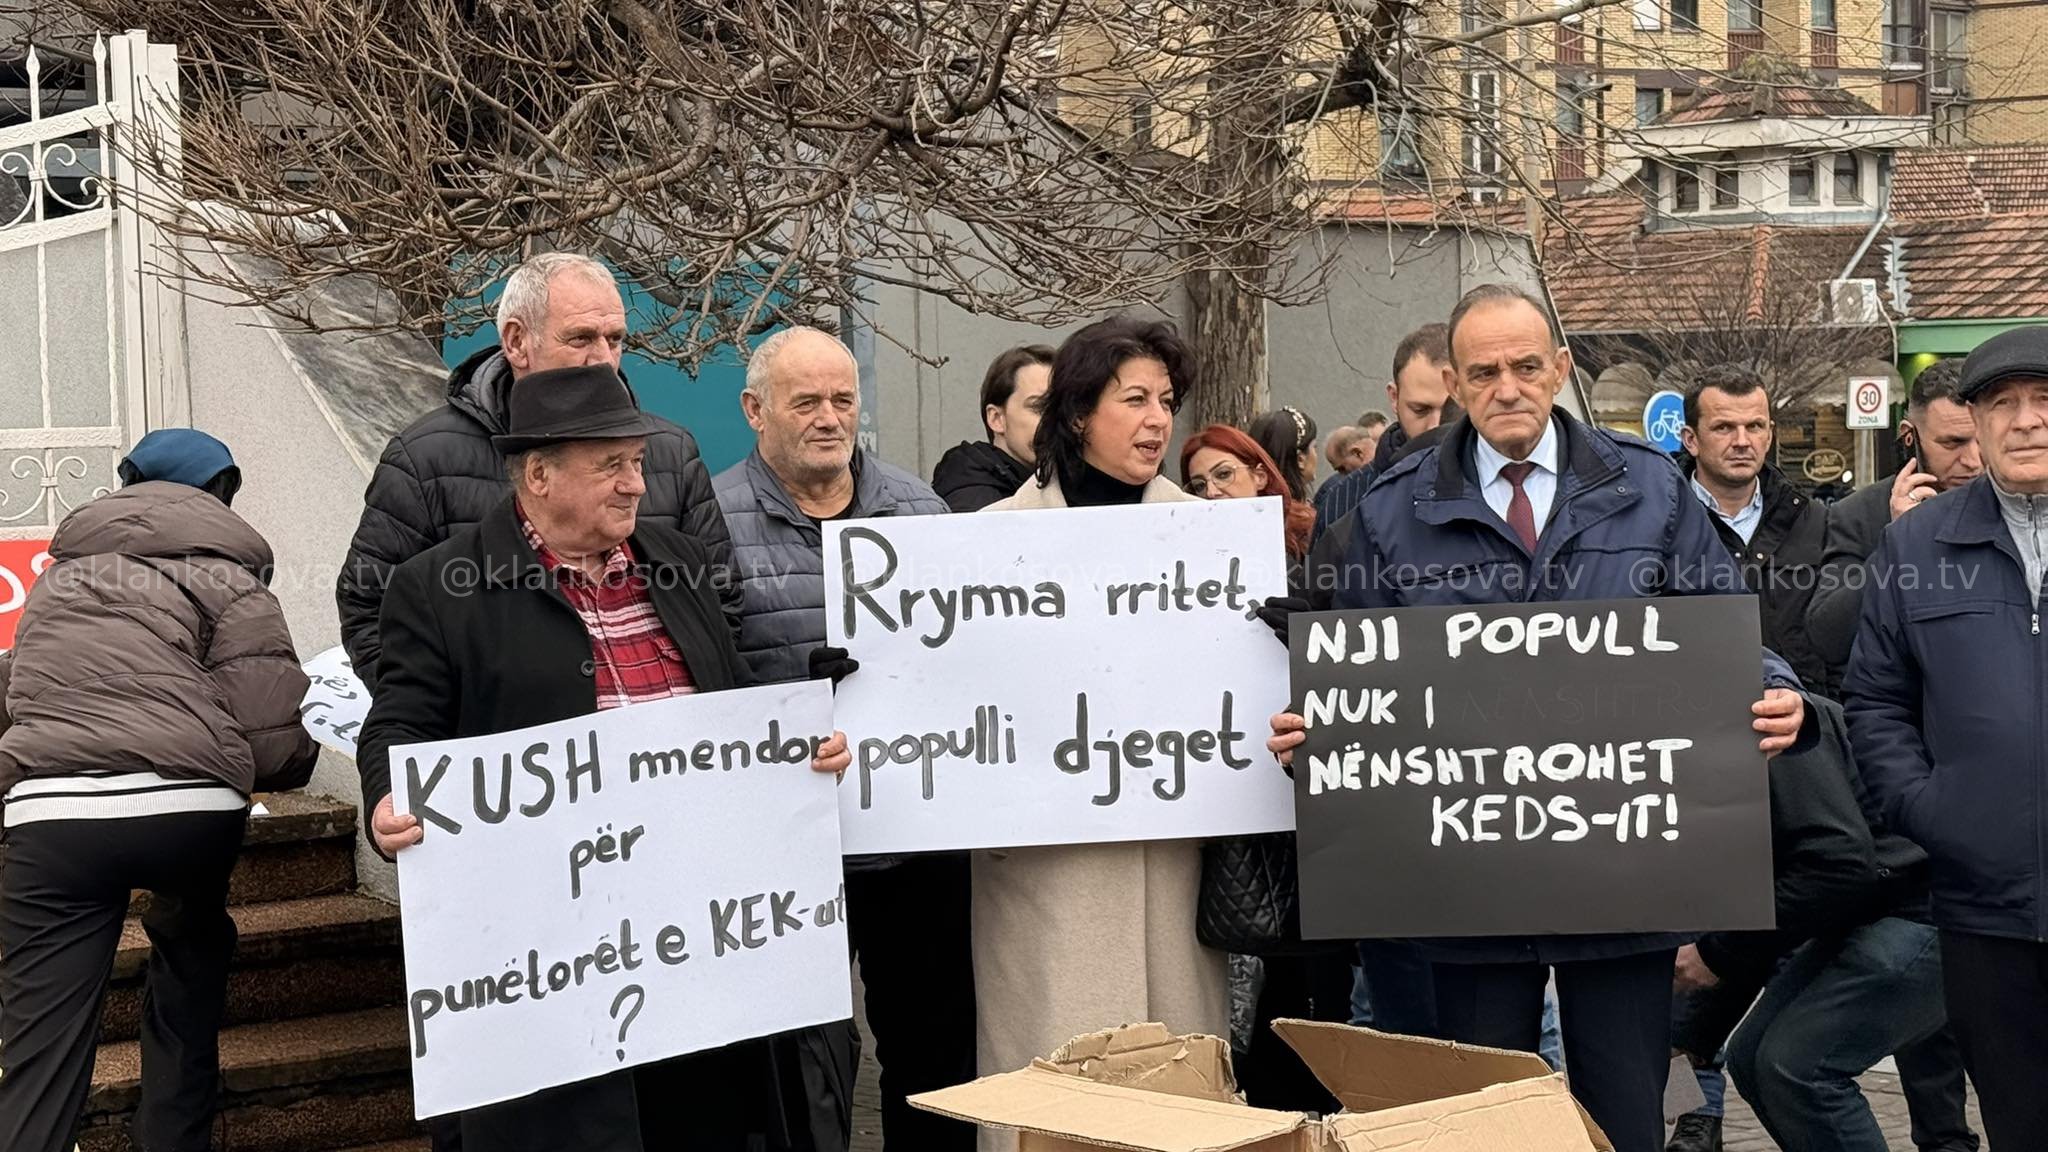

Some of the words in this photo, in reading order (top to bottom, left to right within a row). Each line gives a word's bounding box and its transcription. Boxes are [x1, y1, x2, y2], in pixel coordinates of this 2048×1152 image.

[1861, 391, 1877, 405] 30
[840, 526, 1066, 648] Rryma
[1306, 615, 1400, 664] NJI
[1446, 605, 1680, 659] POPULL
[1304, 687, 1397, 728] NUK
[1425, 686, 1434, 728] I
[405, 730, 602, 844] KUSH
[859, 691, 1016, 809] populli
[1053, 691, 1252, 806] djeget
[1308, 738, 1693, 795] NËNSHTROHET
[1431, 793, 1679, 846] KEDS-IT!
[569, 823, 644, 899] për
[410, 919, 643, 1058] punëtorët
[656, 925, 689, 965] e
[709, 884, 846, 957] KEK-ut
[609, 984, 645, 1061] ?
